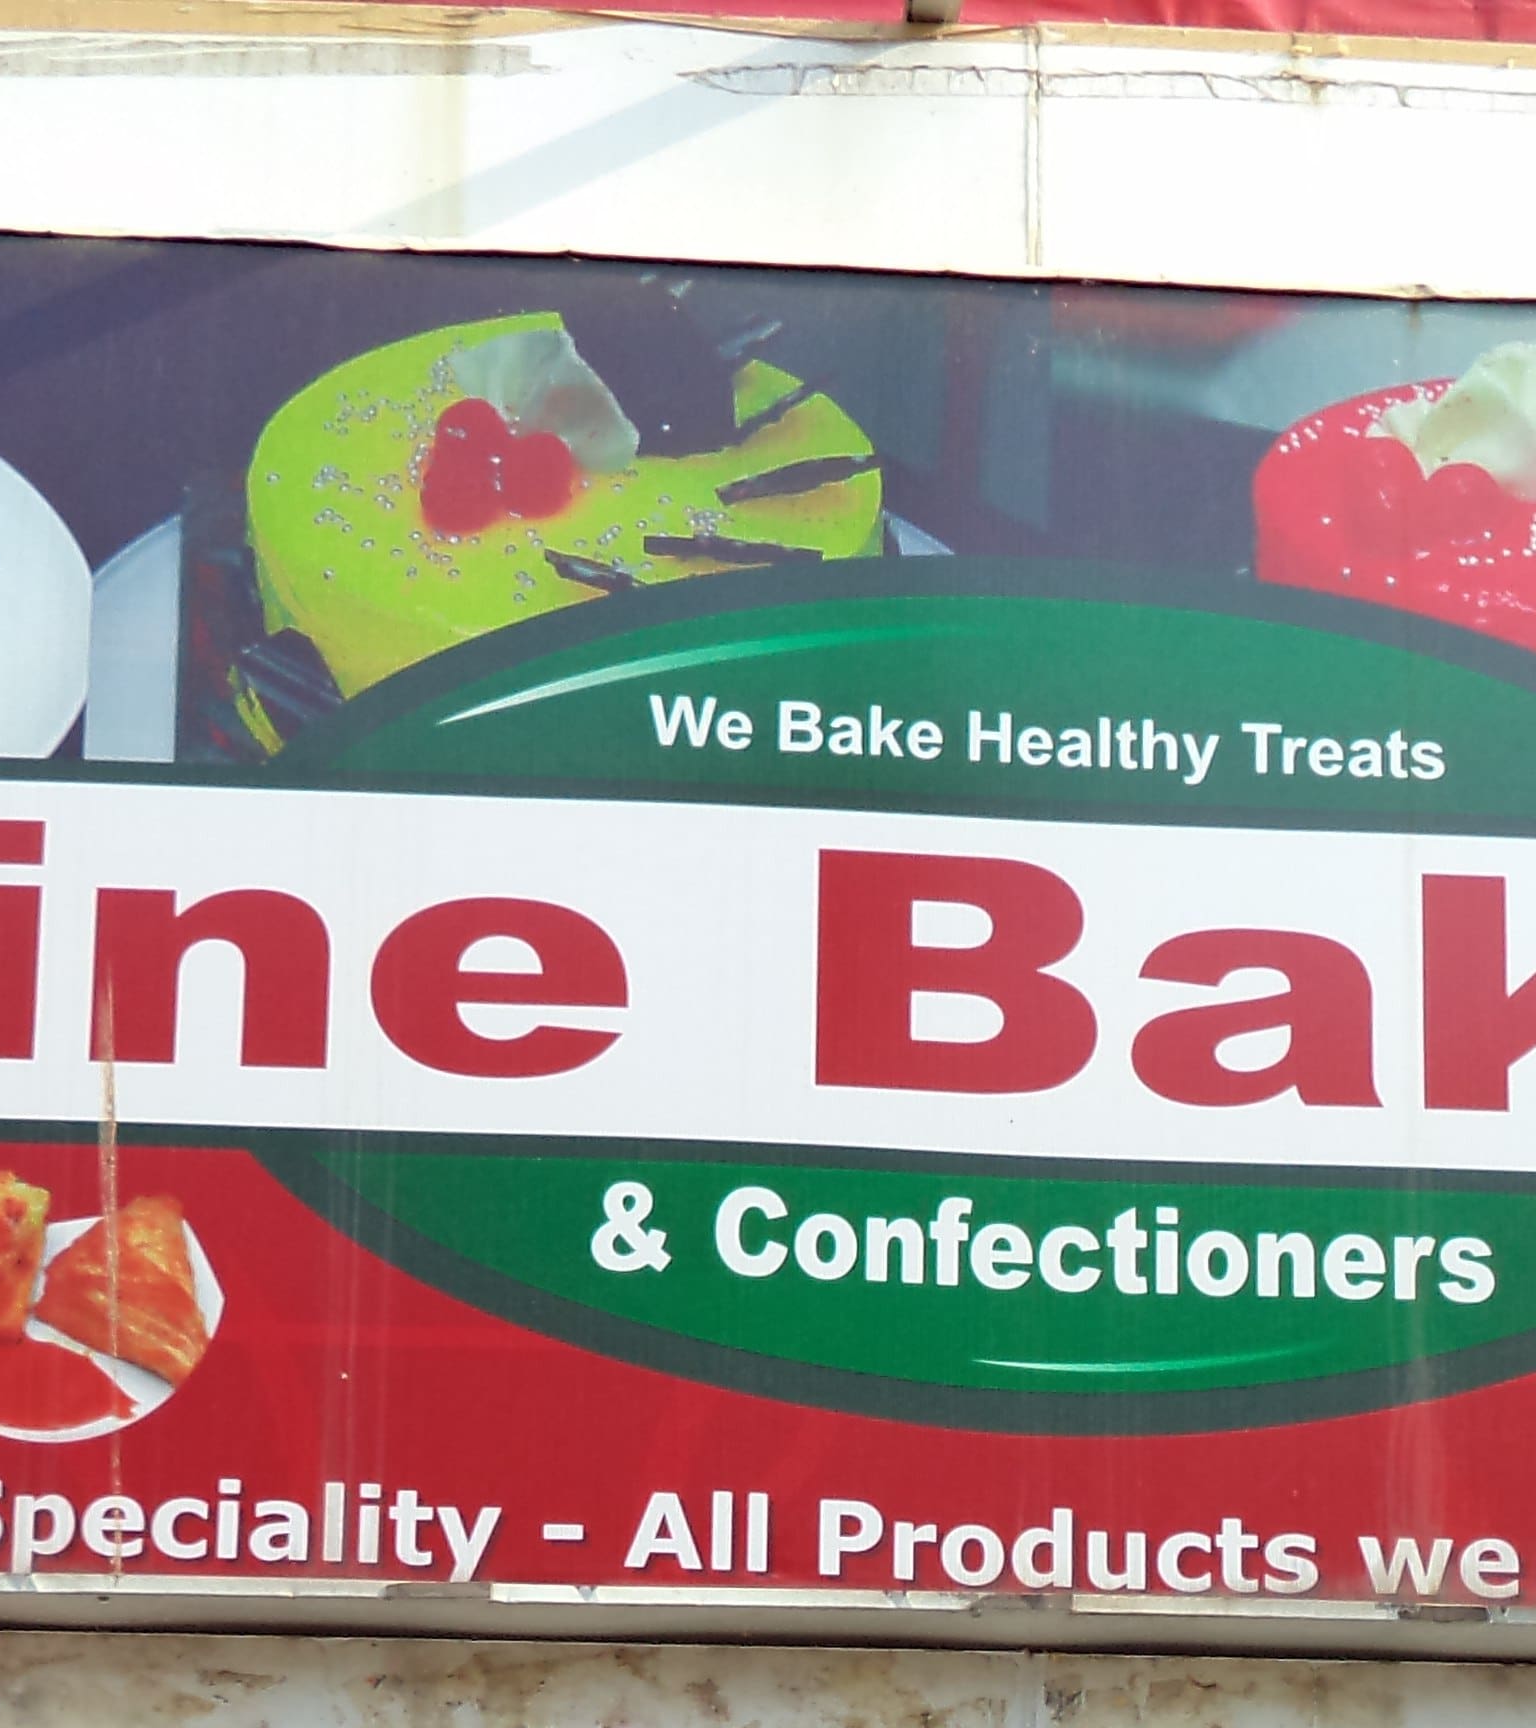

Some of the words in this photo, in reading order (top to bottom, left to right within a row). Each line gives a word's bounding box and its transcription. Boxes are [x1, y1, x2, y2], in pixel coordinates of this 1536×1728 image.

[649, 695, 754, 751] We
[777, 699, 945, 760] Bake
[967, 709, 1220, 785] Healthy
[1241, 721, 1447, 780] Treats
[589, 1180, 672, 1273] &
[713, 1185, 1497, 1304] Confectioners
[623, 1488, 769, 1574] All
[818, 1496, 1320, 1597] Products
[1357, 1533, 1522, 1603] we
